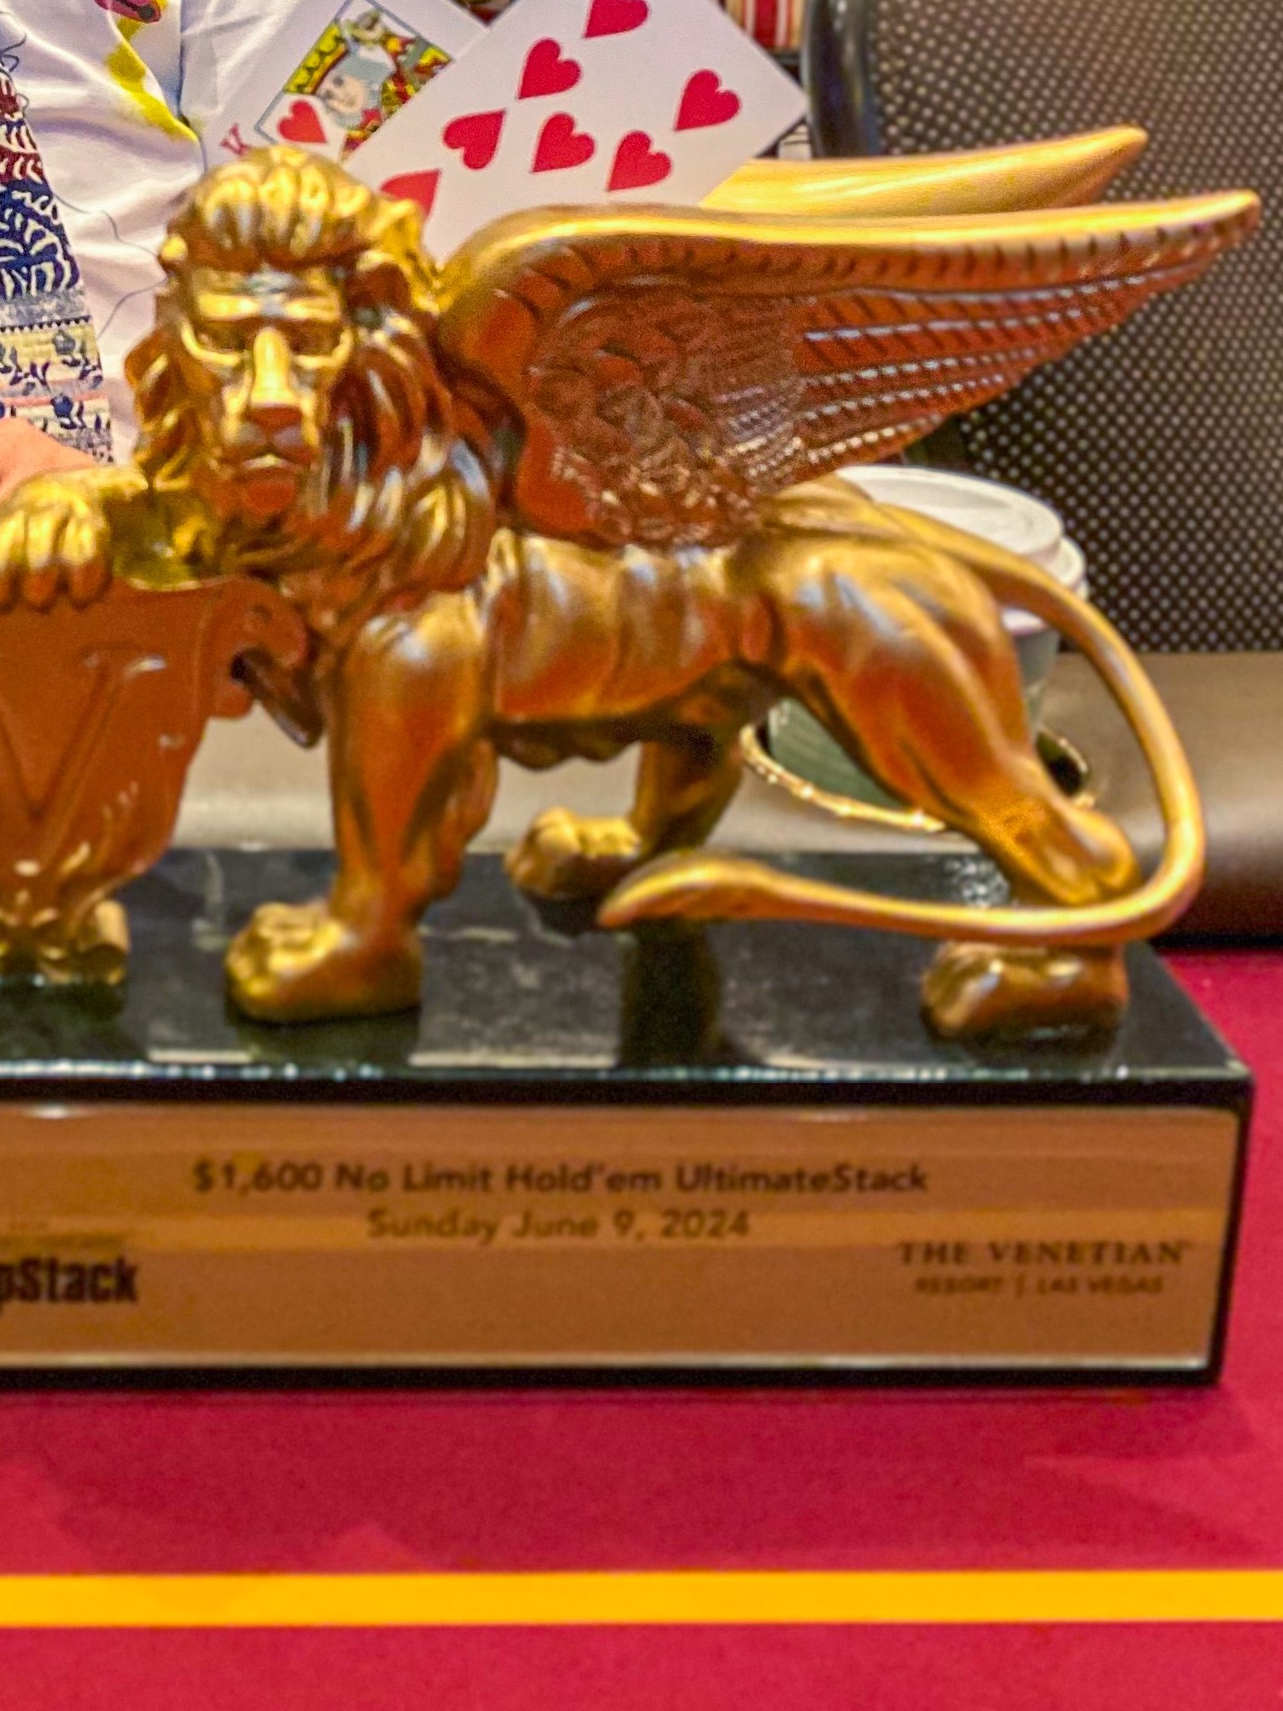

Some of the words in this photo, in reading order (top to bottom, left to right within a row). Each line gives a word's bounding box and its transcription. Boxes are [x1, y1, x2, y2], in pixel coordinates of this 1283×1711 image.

[193, 1159, 322, 1196] $1,600
[336, 1163, 390, 1192] No
[403, 1162, 492, 1192] Limit
[505, 1162, 662, 1192] Hold'em
[675, 1161, 928, 1192] UltimateStack
[368, 1207, 500, 1246] Sunday
[512, 1208, 599, 1238] June
[613, 1209, 646, 1241] 9,
[661, 1208, 751, 1238] 2024
[897, 1241, 968, 1266] THE
[986, 1241, 1183, 1266] VENETIAN
